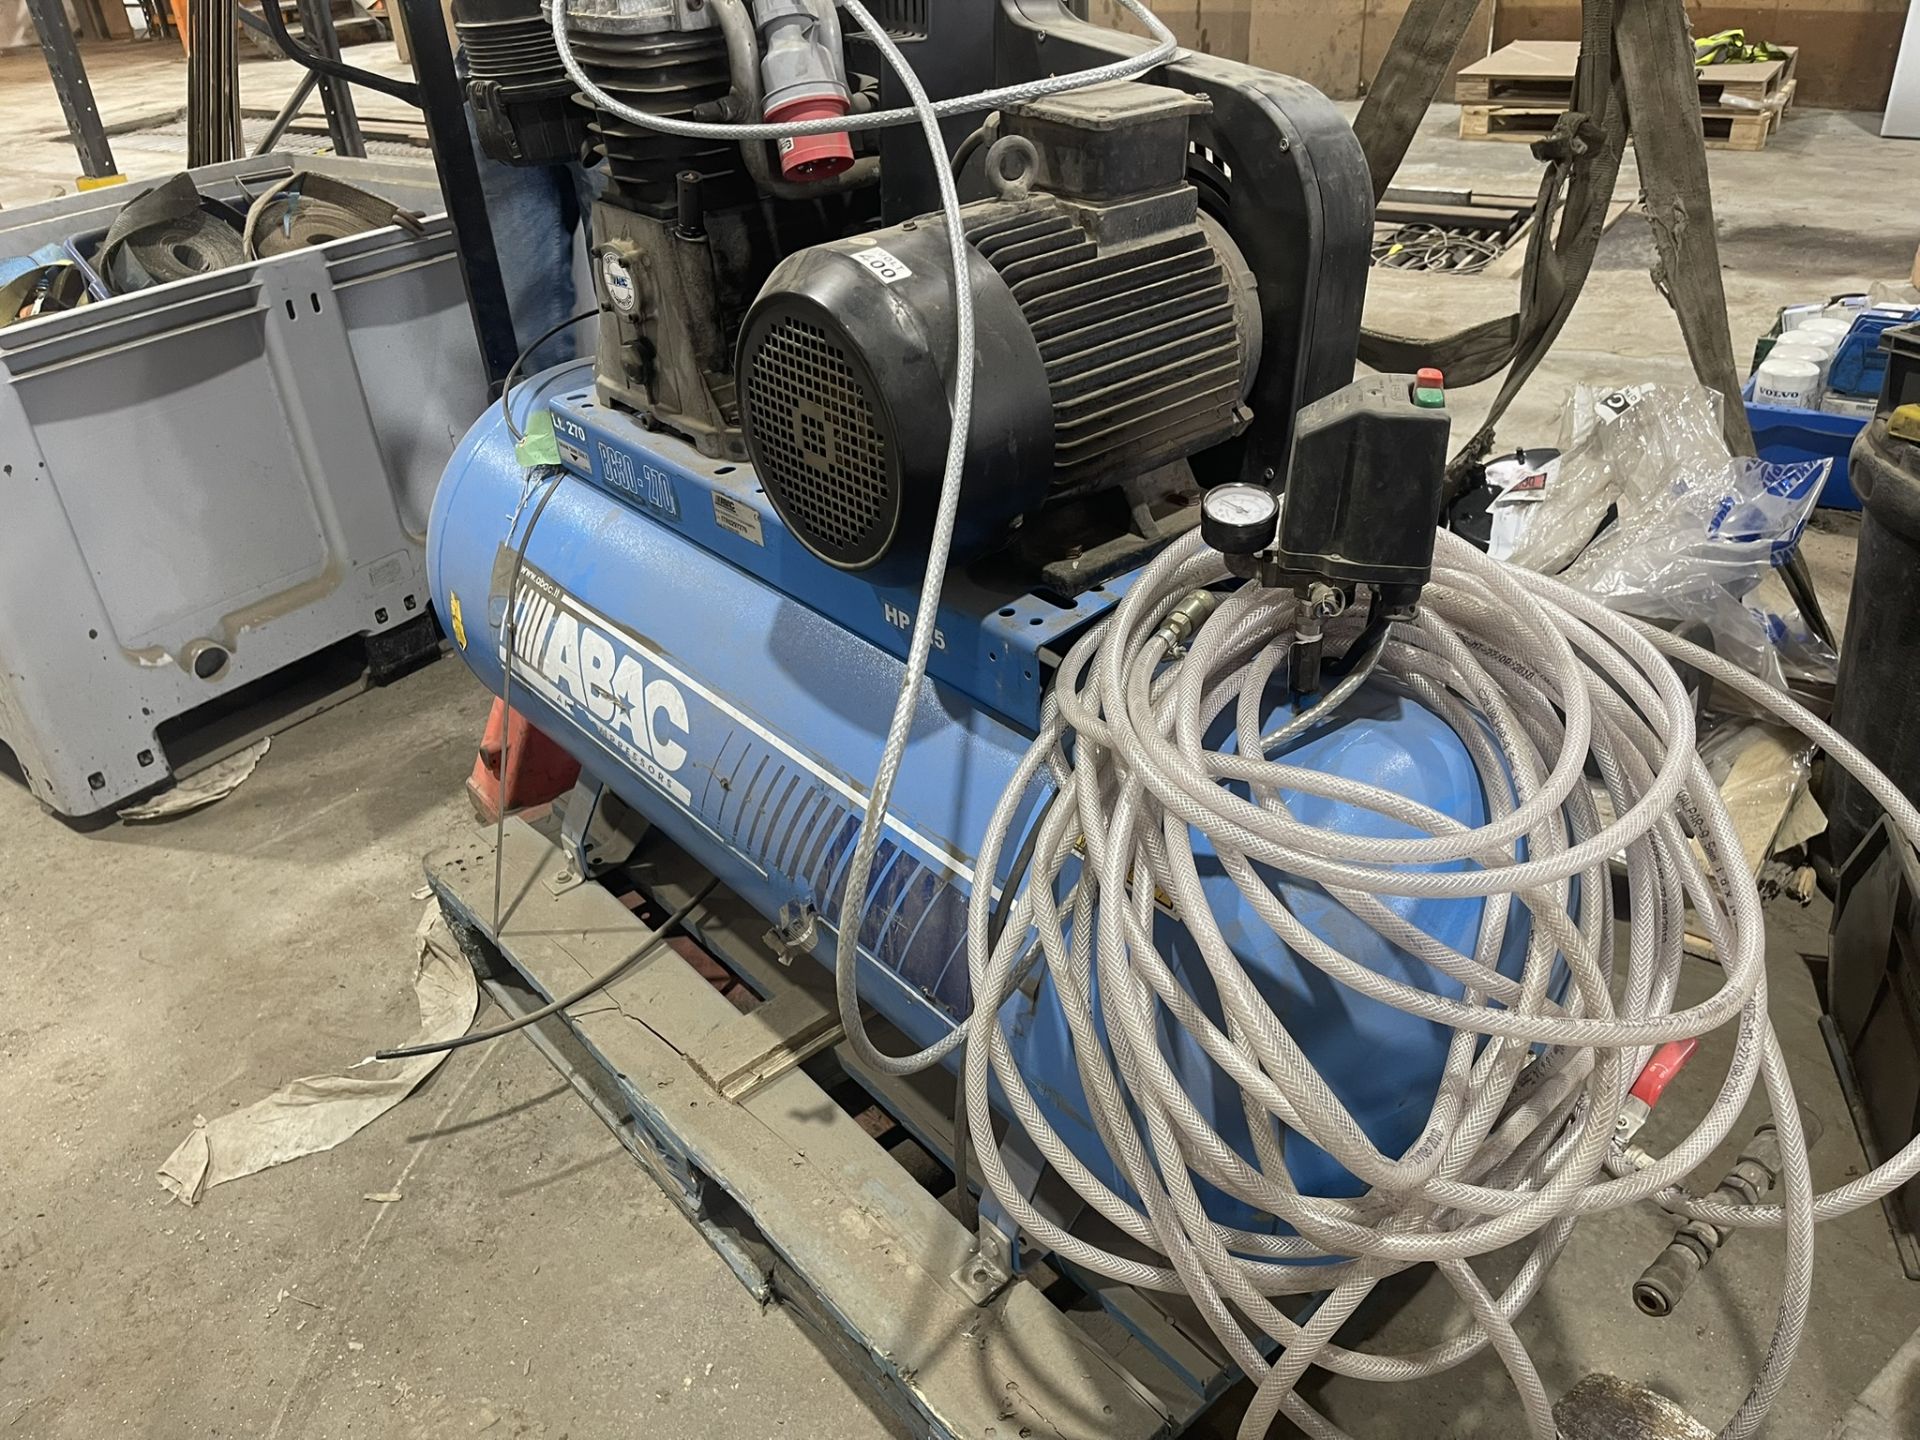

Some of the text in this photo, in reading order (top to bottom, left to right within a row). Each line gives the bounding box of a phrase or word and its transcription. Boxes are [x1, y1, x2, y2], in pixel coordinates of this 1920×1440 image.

[858, 254, 897, 278] 400
[1759, 387, 1799, 399] VOLVO
[566, 420, 586, 442] 270
[884, 603, 911, 630] HP
[543, 610, 690, 773] ABAC
